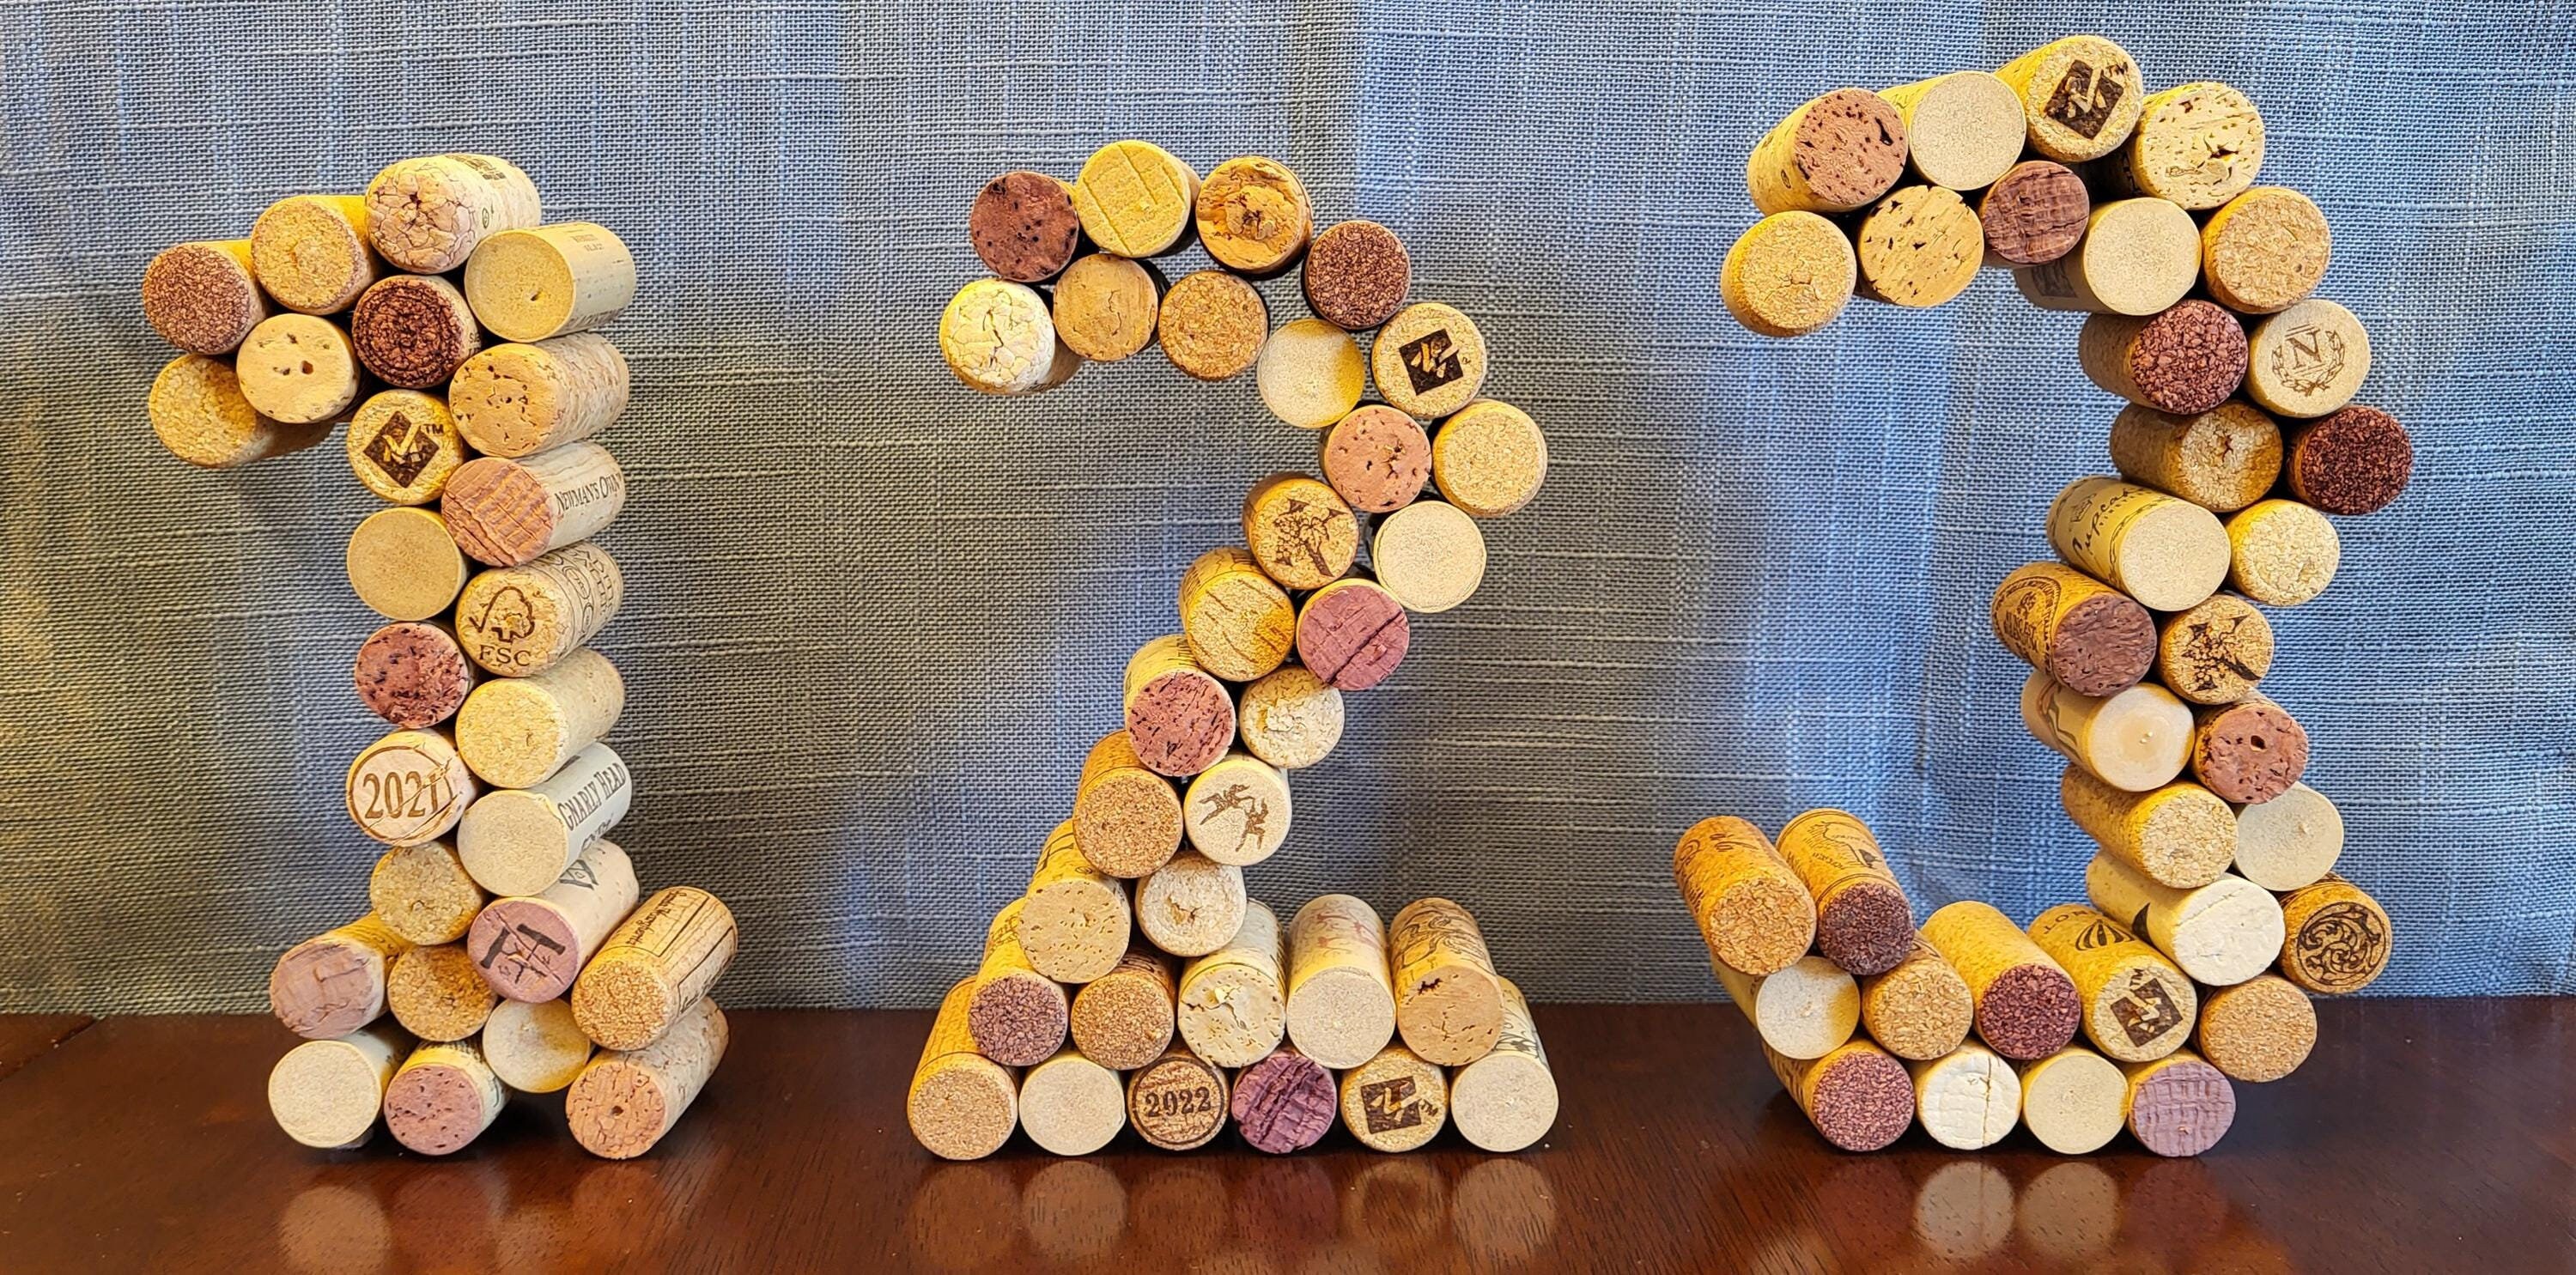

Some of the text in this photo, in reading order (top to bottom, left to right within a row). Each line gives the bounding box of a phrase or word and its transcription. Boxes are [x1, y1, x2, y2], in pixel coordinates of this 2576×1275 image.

[2285, 328, 2321, 369] N
[423, 423, 444, 434] TM
[555, 483, 600, 515] NEWMAN'S
[479, 644, 532, 667] FSC
[362, 770, 439, 820] 2021
[557, 762, 626, 831] GNARLY HEAD
[1145, 1086, 1212, 1118] 2022
